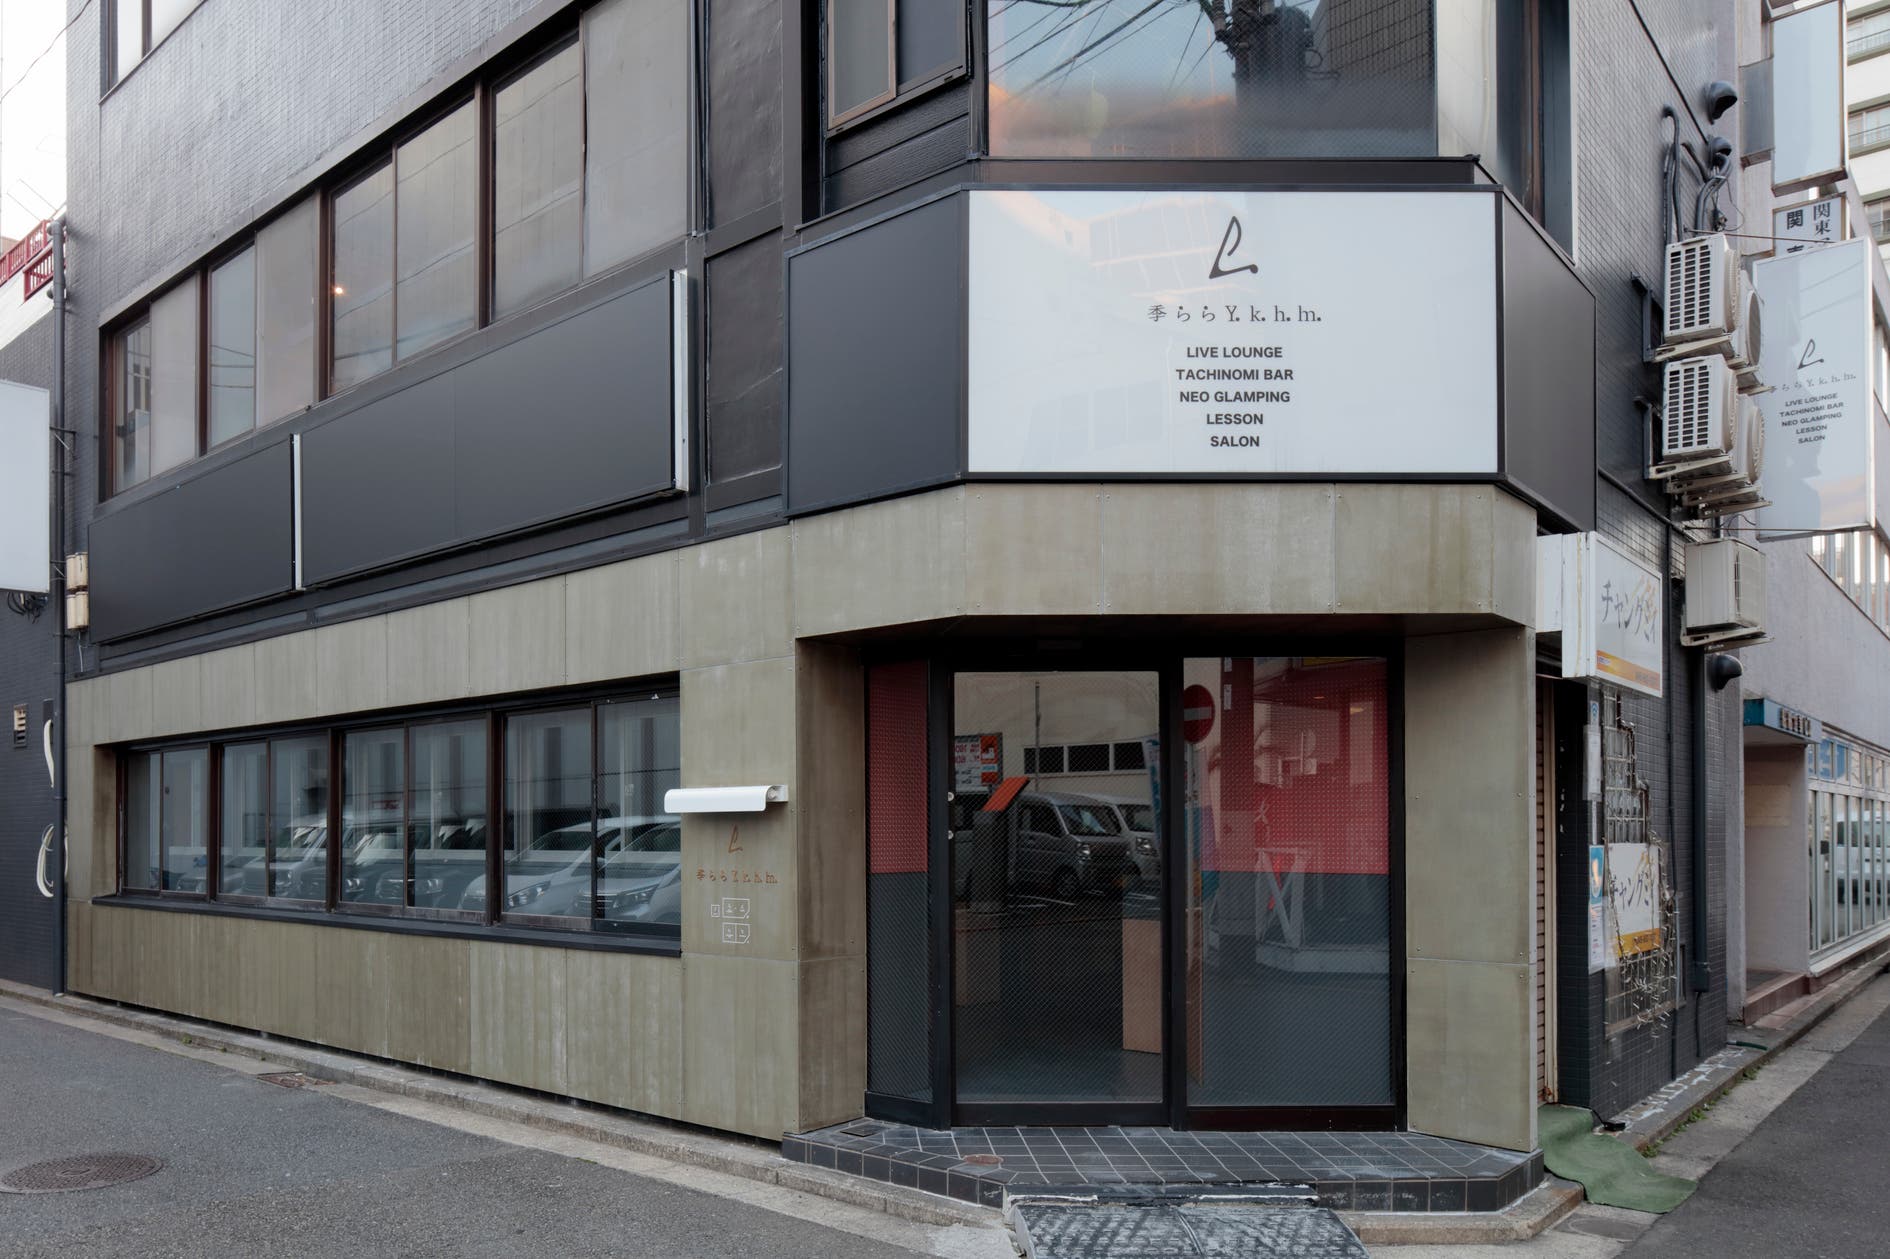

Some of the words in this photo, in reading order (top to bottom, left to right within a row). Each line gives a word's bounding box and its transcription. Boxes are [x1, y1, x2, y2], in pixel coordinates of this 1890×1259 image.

[1186, 347, 1219, 358] LIVE
[1223, 347, 1283, 358] LOUNGE
[1176, 369, 1259, 380] TACHINOMI
[1264, 369, 1294, 380] BAR
[1179, 391, 1210, 403] NEO
[1214, 391, 1291, 403] GLAMPING
[1785, 399, 1804, 407] LIVE
[1804, 392, 1838, 404] LOUNGE
[1779, 405, 1825, 417] TACHINOMI
[1827, 401, 1844, 410] BAR
[1206, 413, 1264, 425] LESSON
[1781, 419, 1799, 427] NEO
[1800, 412, 1843, 424] GLAMPING
[1796, 424, 1828, 435] LESSON
[1210, 435, 1260, 447] SALON
[1798, 435, 1826, 444] SALON
